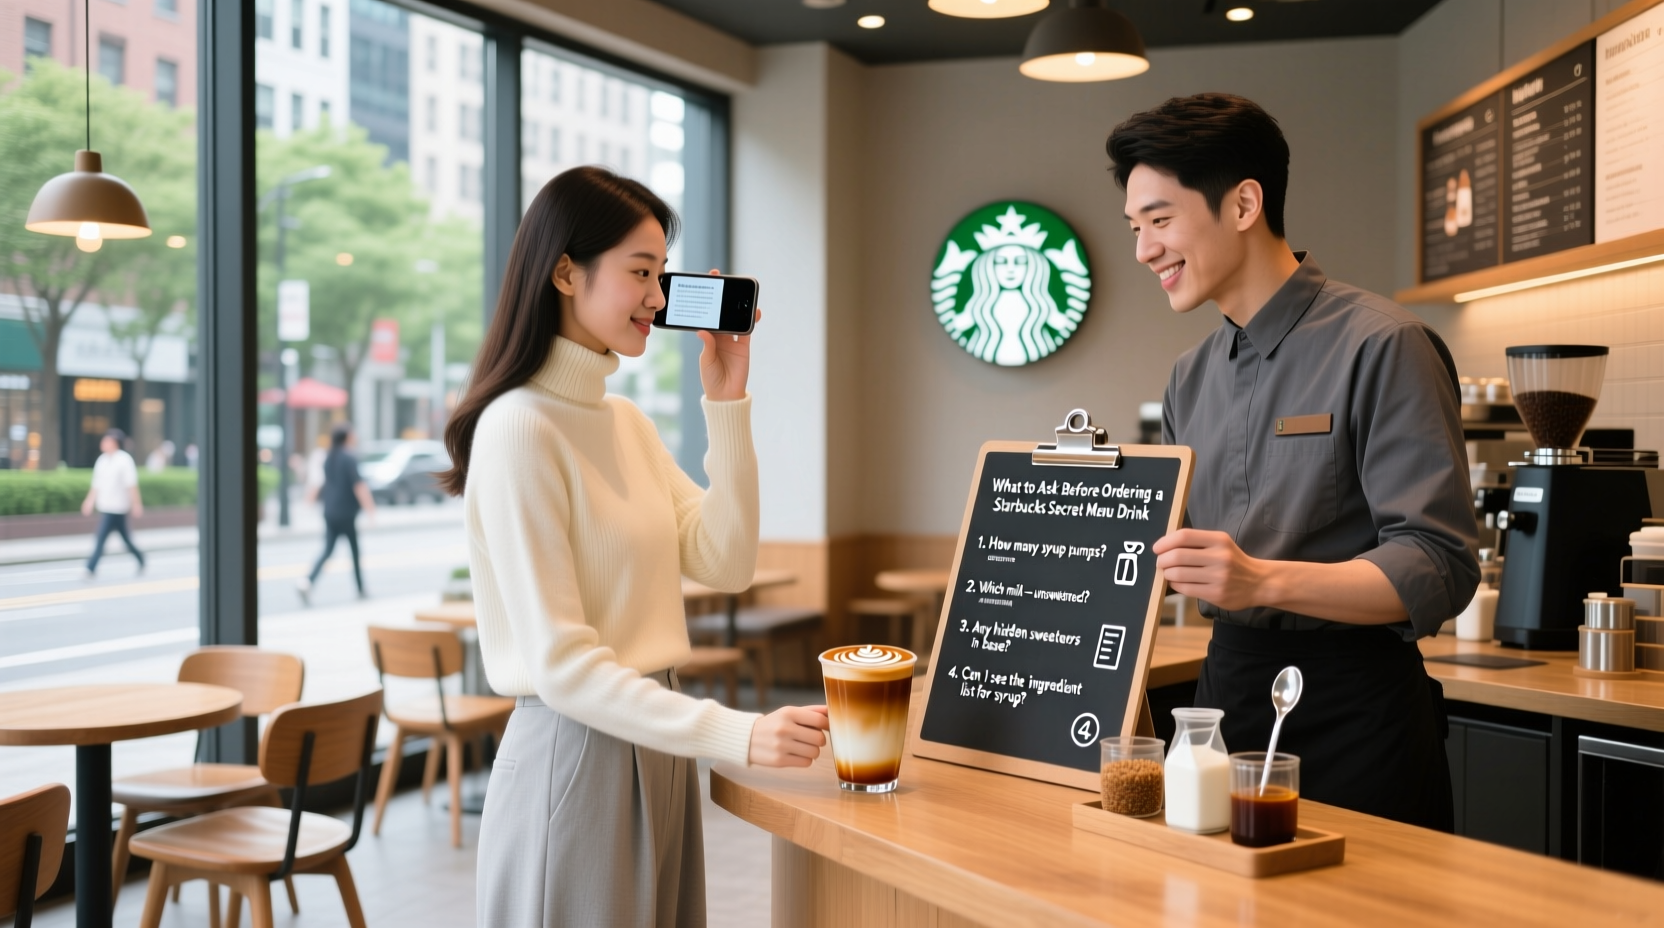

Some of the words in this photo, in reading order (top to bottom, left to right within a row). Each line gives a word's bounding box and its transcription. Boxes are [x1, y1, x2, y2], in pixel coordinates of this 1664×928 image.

[992, 477, 1021, 494] What
[1024, 481, 1035, 494] to
[1037, 480, 1060, 496] Ask
[1061, 482, 1100, 497] Before
[1101, 483, 1152, 503] Ordering
[1155, 490, 1163, 501] a
[992, 497, 1046, 514] Starbucks
[1048, 500, 1084, 516] Secret
[1117, 503, 1149, 520] Drink
[978, 535, 986, 549] 1.
[988, 536, 1011, 551] How
[966, 579, 976, 593] 2.
[959, 619, 969, 632] 3.
[972, 621, 992, 639] Any
[948, 666, 958, 679] 4.
[984, 669, 989, 683] I
[994, 691, 1027, 708] syrup?
[1077, 720, 1091, 740] 4
